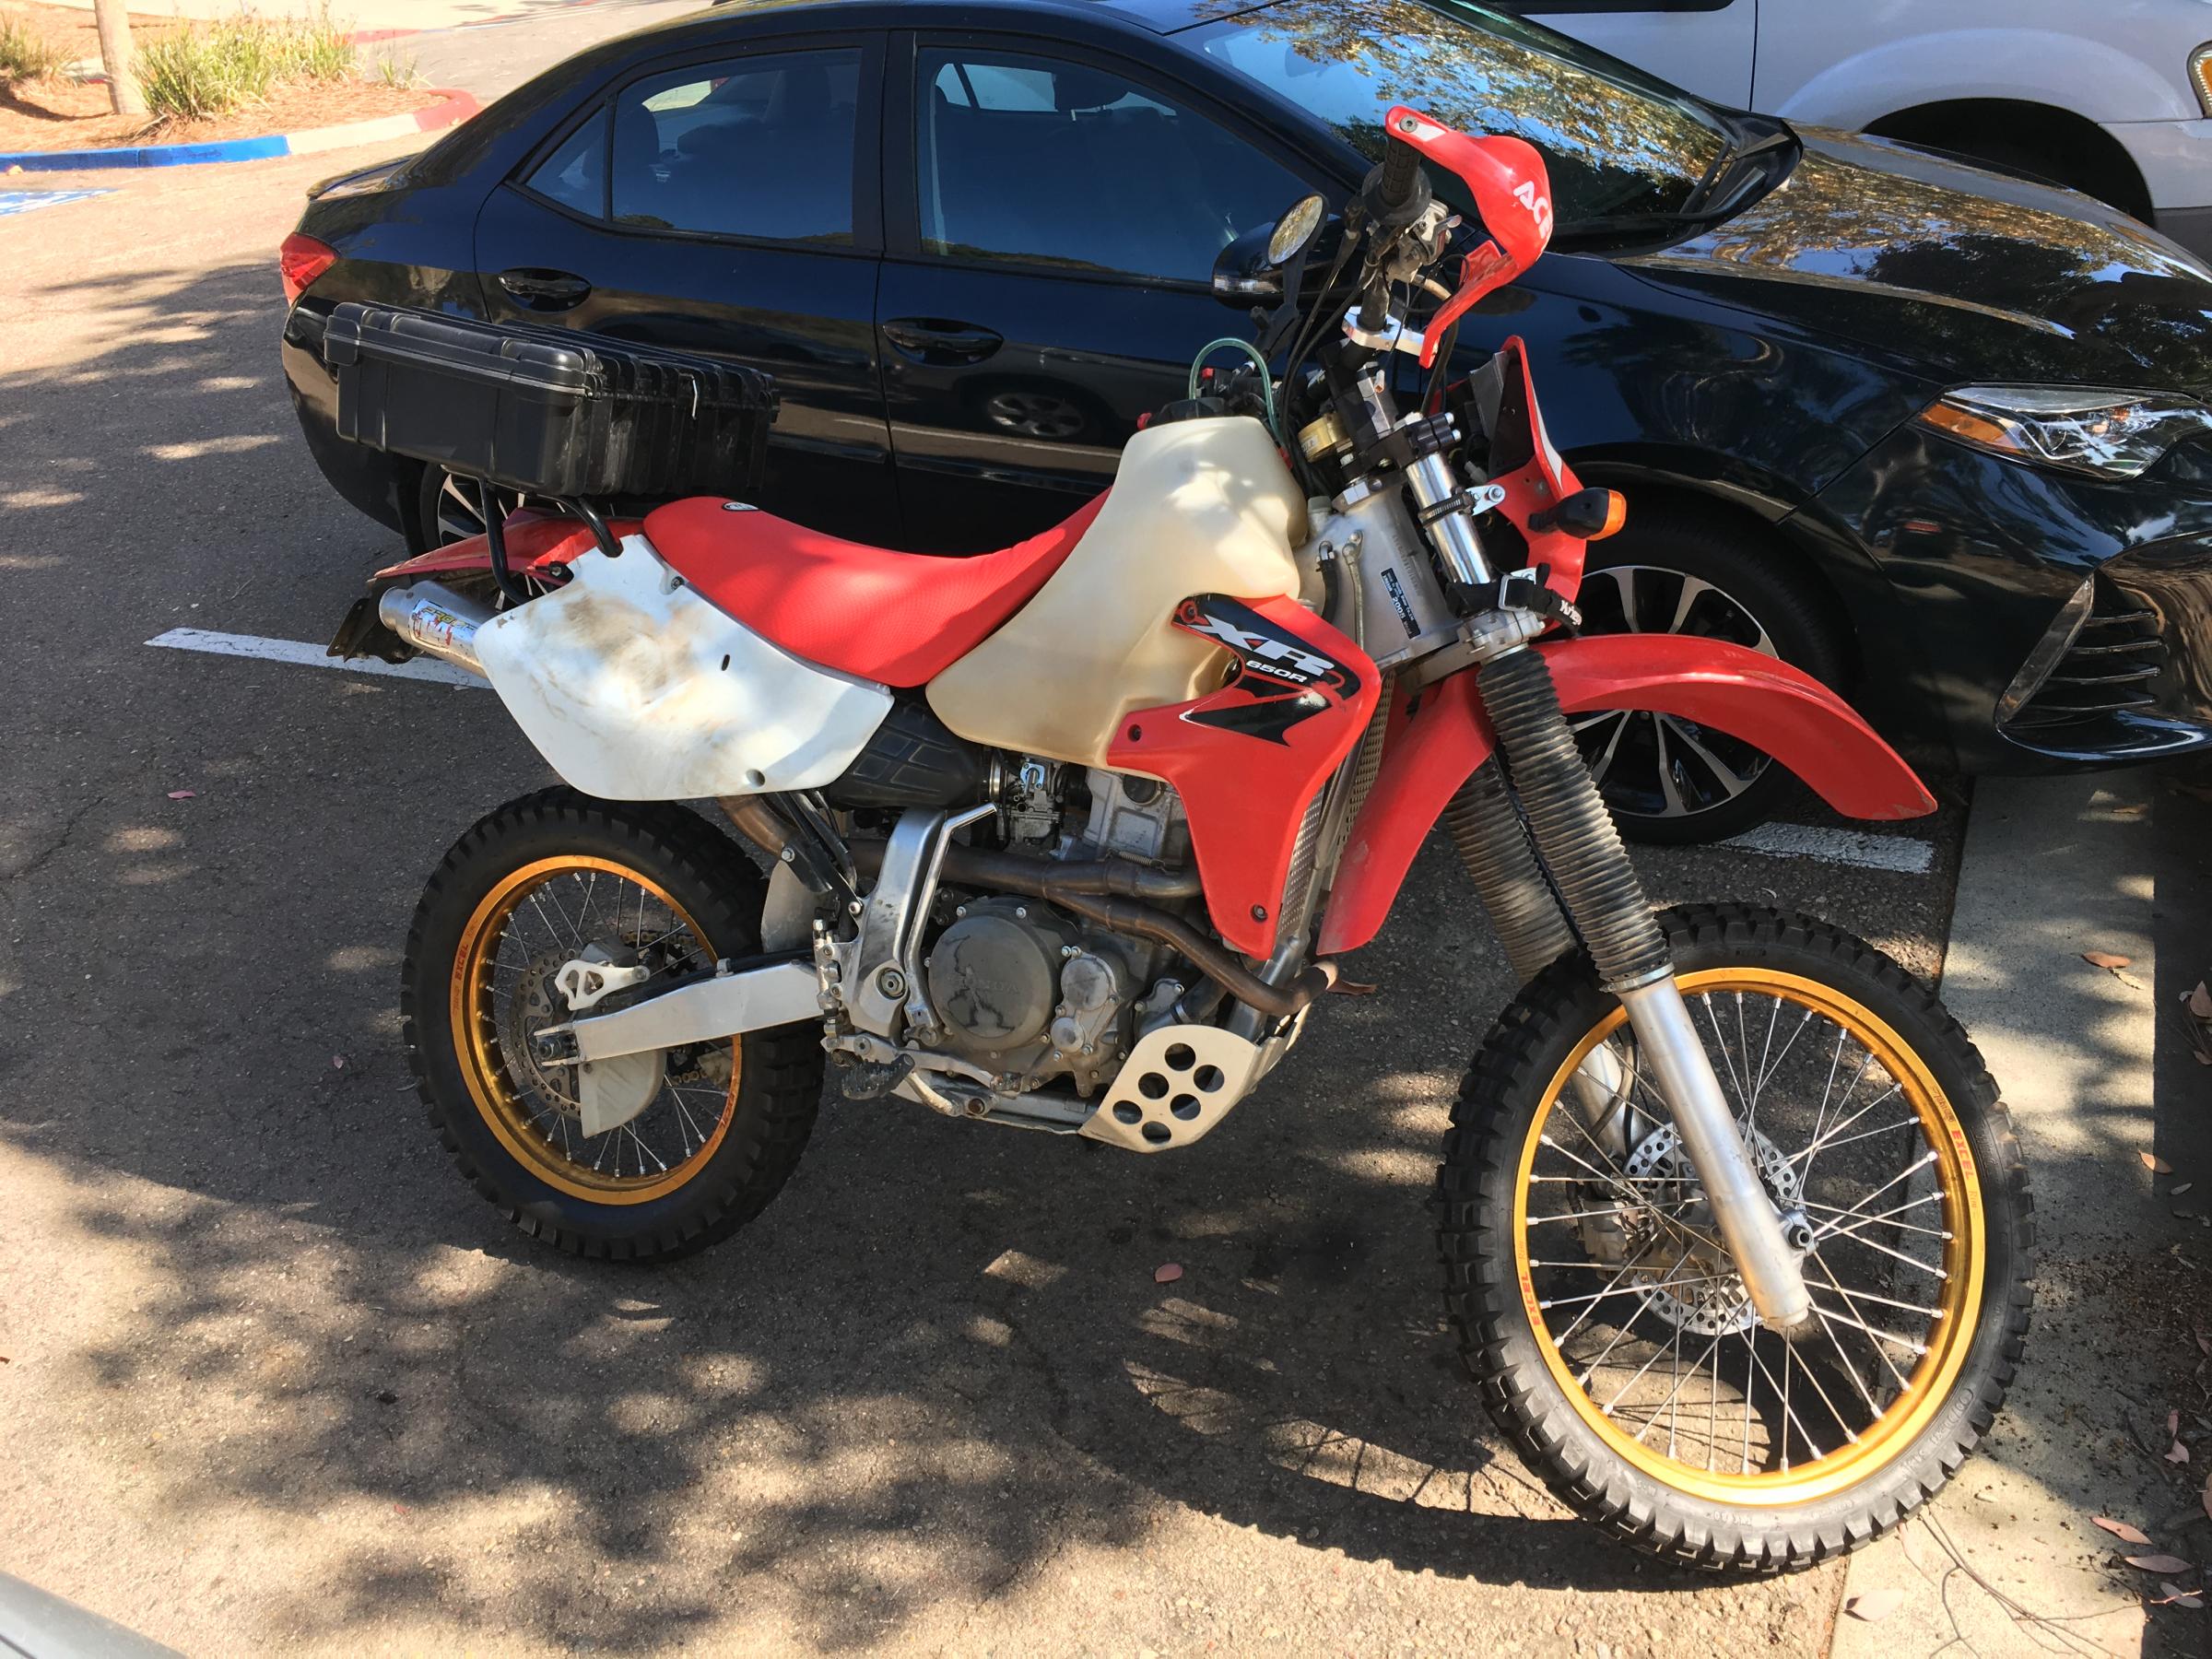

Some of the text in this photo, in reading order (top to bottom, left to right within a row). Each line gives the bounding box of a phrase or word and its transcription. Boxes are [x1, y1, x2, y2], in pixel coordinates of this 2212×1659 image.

[1187, 614, 1335, 677] XR
[1245, 660, 1308, 683] 650R
[455, 944, 468, 982] EXCEL
[1951, 1130, 1975, 1181] EXCEL
[1521, 1271, 1542, 1326] EXCEL
